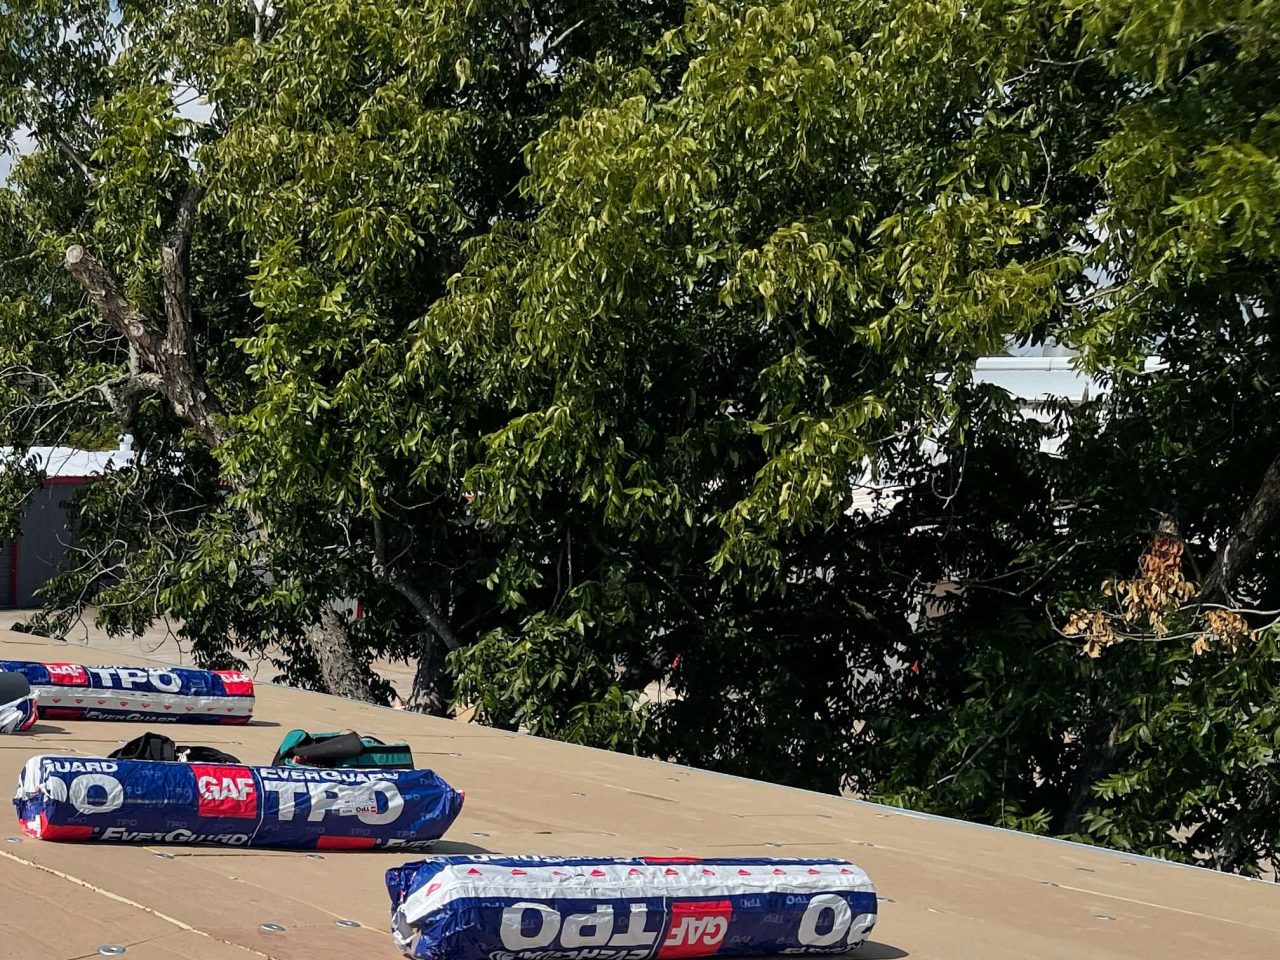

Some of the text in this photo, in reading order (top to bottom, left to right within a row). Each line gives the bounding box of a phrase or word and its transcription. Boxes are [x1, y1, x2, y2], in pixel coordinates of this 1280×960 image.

[46, 664, 84, 676] GAF
[87, 668, 181, 692] TPO
[196, 776, 254, 802] GAF
[262, 779, 404, 825] TPO
[500, 901, 658, 950] TPO
[664, 916, 730, 946] GAF
